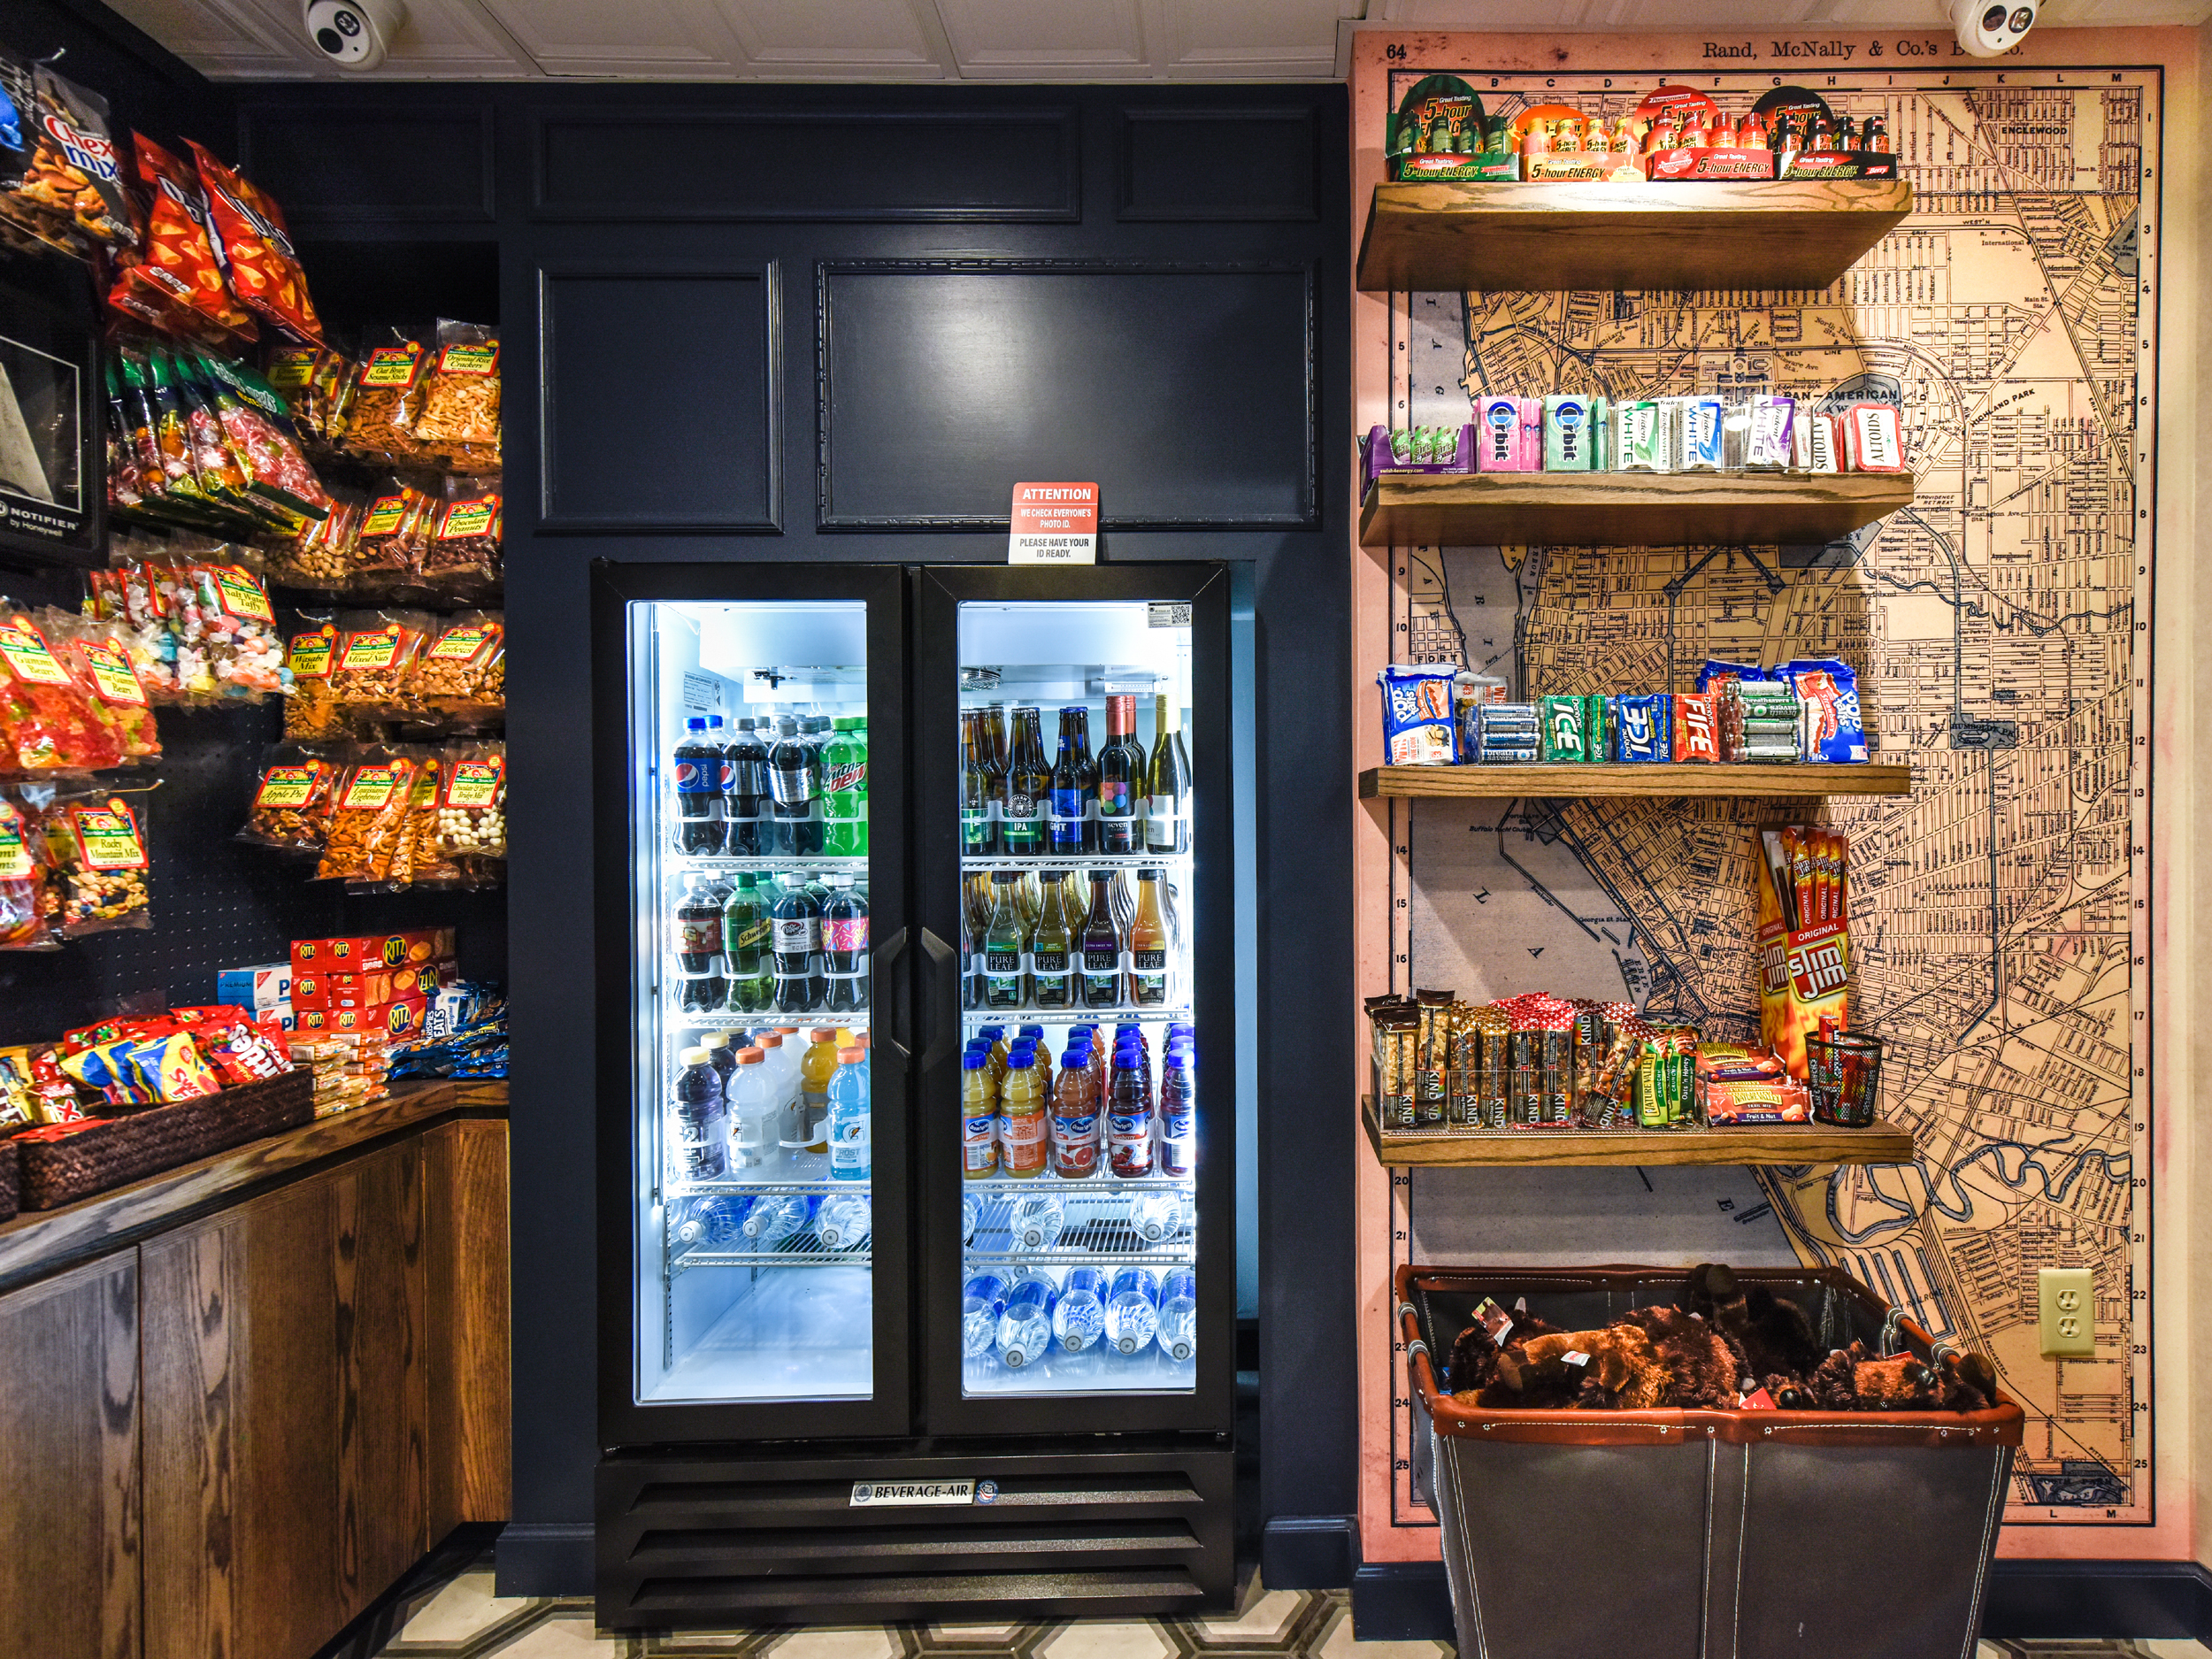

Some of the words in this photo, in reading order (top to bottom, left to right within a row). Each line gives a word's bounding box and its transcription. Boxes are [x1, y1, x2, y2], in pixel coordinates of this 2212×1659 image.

[1386, 44, 1407, 58] 64
[1702, 42, 1757, 60] Rand,
[1770, 41, 1856, 60] McNally
[1869, 41, 1884, 55] &
[1896, 41, 1938, 56] Co.'s
[1547, 78, 1555, 88] C
[1604, 78, 1612, 88] D
[1772, 78, 1781, 87] G
[1827, 76, 1836, 85] H
[1997, 74, 2005, 83] K
[2111, 73, 2122, 82] M
[45, 116, 114, 158] Chex
[70, 144, 119, 180] mix
[1403, 163, 1440, 177] 5-hour
[1440, 166, 1478, 177] ENERGY
[1696, 157, 1733, 173] 5-hour
[1733, 162, 1770, 173] ENERGY
[1782, 161, 1819, 178] 5-hour
[1819, 165, 1858, 178] ENERGY
[1531, 165, 1567, 178] 5-hour
[1568, 168, 1605, 178] ENERGY
[447, 355, 475, 365] Oriental
[367, 373, 389, 381] Sesame
[390, 373, 408, 381] Sticks
[375, 366, 388, 375] Oat
[389, 366, 406, 375] Bran
[1784, 391, 1811, 400] PAN
[1826, 389, 1897, 400] AMERICAN
[2012, 388, 2035, 405] PARK
[1638, 411, 1648, 444] Trident
[1702, 411, 1711, 444] Trident
[1753, 401, 1770, 457] WHITE
[1771, 407, 1782, 438] Trident
[1486, 401, 1518, 462] Orbit
[1555, 401, 1585, 462] Orbit
[1624, 408, 1633, 464] WHITE
[1688, 408, 1698, 463] WHITE
[1866, 412, 1884, 463] ALTOIDS
[1815, 422, 1829, 470] ALTOIDS
[1023, 488, 1091, 499] ATTENTION
[11, 508, 77, 530] NOTIFIER
[448, 518, 488, 526] Chocolate
[1040, 519, 1062, 528] PHOTO
[10, 518, 20, 528] by
[21, 521, 63, 537] Honeywell
[449, 524, 482, 534] Peanuts
[225, 588, 242, 598] Salt
[243, 591, 266, 605] Water
[238, 595, 262, 611] Taffy
[1396, 623, 1407, 632] 10
[2136, 622, 2147, 632] 10
[434, 644, 473, 655] Cashews
[294, 653, 324, 664] Wasabi
[297, 661, 318, 671] Mix
[345, 654, 370, 664] Mixed
[371, 654, 389, 663] Nuts
[1417, 655, 1458, 664] FORT
[28, 664, 57, 677] Bears
[2136, 678, 2143, 687] 11
[1571, 698, 1582, 729] Dentyne
[1704, 696, 1715, 727] Dentyne
[1819, 692, 1835, 733] Strawberry
[1553, 703, 1581, 751] ICE
[1622, 704, 1652, 754] ICE
[1684, 697, 1714, 754] FIRE
[1624, 728, 1633, 759] Dentyne
[2134, 736, 2146, 746] 12
[262, 788, 288, 802] Apple
[289, 788, 305, 798] Pie
[2134, 788, 2145, 798] 13
[101, 838, 122, 849] Rocky
[1396, 846, 1408, 855] 14
[2133, 846, 2145, 856] 14
[90, 849, 124, 859] Mountain
[125, 848, 140, 858] Mix
[2134, 900, 2145, 910] 15
[1763, 923, 1784, 935] ORIGINAL
[1797, 923, 1839, 941] ORIGINAL
[300, 944, 315, 957] RITZ
[334, 941, 349, 956] RITZ
[383, 938, 406, 963] RITZ
[1789, 945, 1844, 978] slim
[2134, 956, 2145, 966] 16
[300, 979, 315, 993] RITZ
[1804, 961, 1847, 1000] Jim
[307, 1013, 323, 1026] RITZ
[339, 1012, 356, 1026] RITZ
[388, 1006, 411, 1032] RITZ
[2134, 1011, 2145, 1020] 17
[1581, 1015, 1591, 1045] KIND
[1642, 1056, 1654, 1084] VALLEY
[2134, 1067, 2144, 1078] 18
[1428, 1071, 1440, 1101] KIND
[1645, 1085, 1658, 1114] NATURE
[1734, 1094, 1755, 1103] NATURE
[1402, 1095, 1413, 1124] KIND
[1467, 1095, 1479, 1124] KIND
[1494, 1098, 1505, 1127] KIND
[1528, 1094, 1539, 1125] KIND
[1554, 1094, 1566, 1121] KIND
[2134, 1123, 2145, 1133] 19
[2049, 1142, 2084, 1177] LACKAWANNA
[1985, 1340, 2008, 1376] ROCHESTER
[2089, 1446, 2118, 1474] PITTSBURG
[875, 1485, 968, 1498] BEVERAGE-AIR
